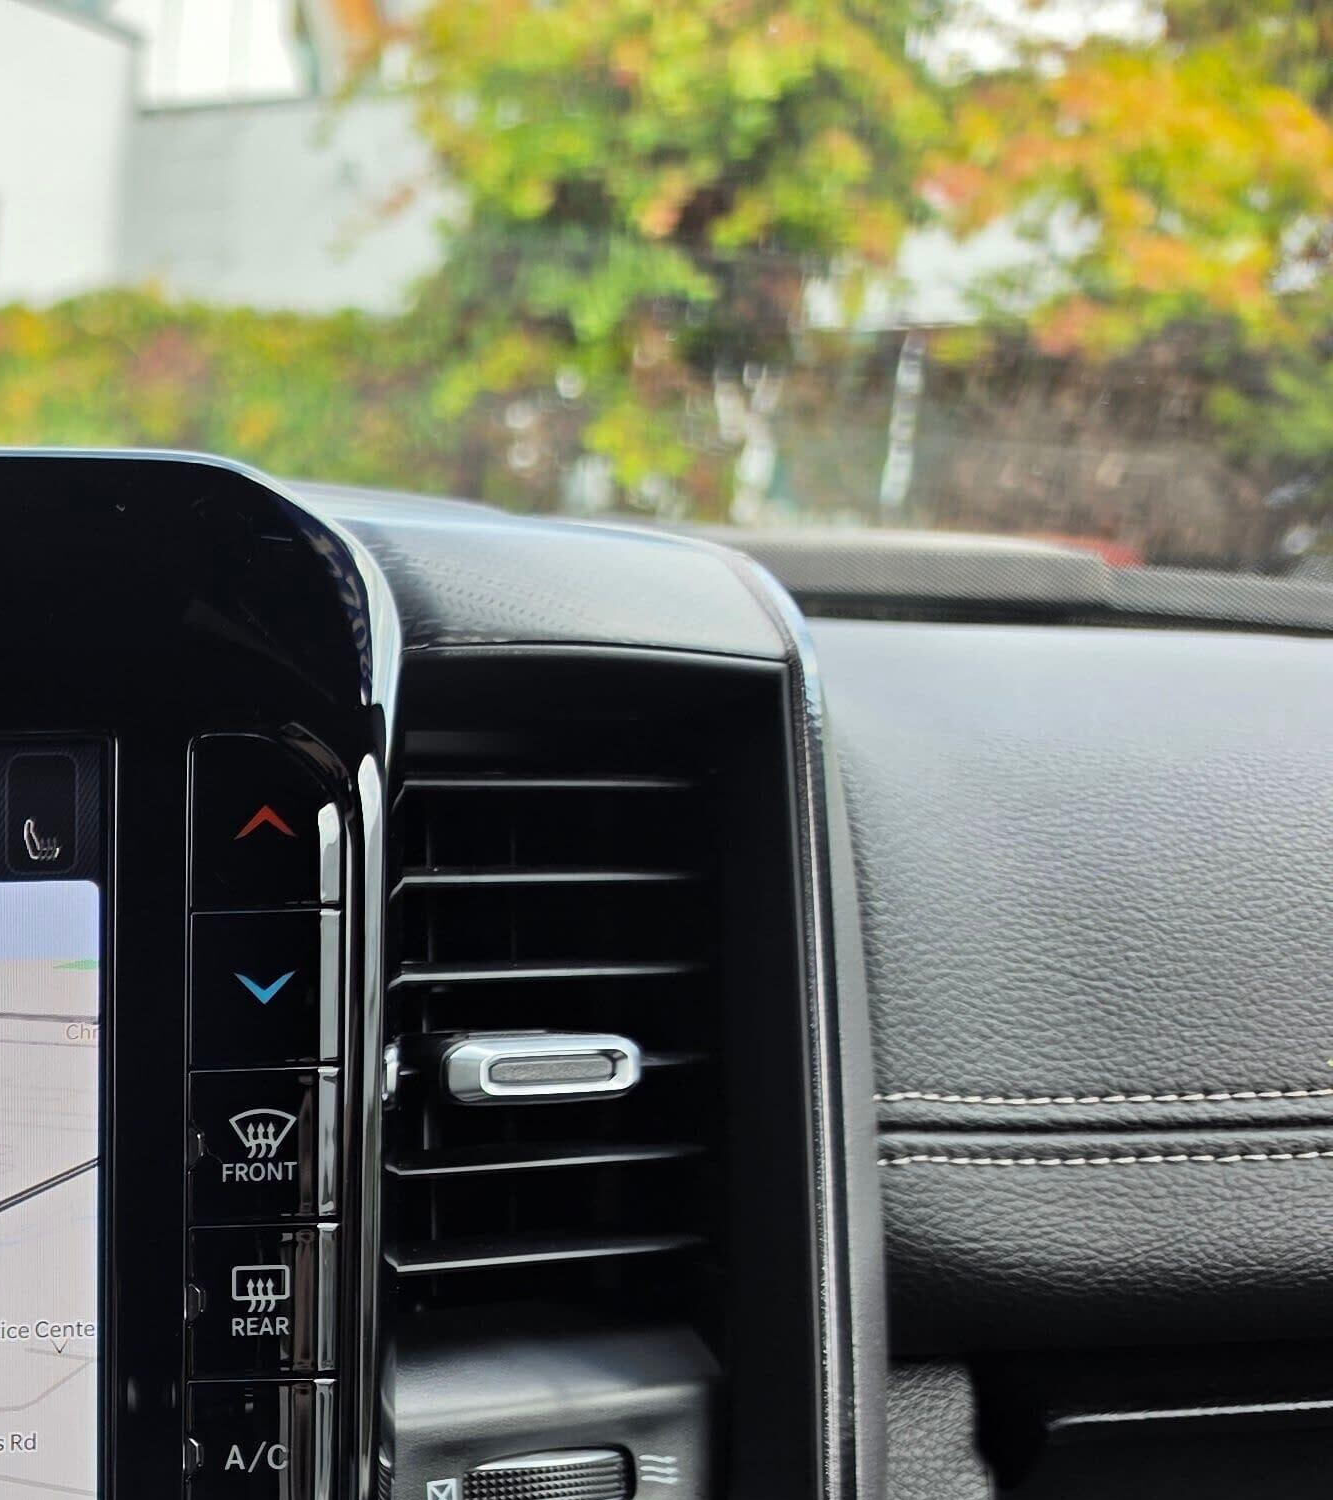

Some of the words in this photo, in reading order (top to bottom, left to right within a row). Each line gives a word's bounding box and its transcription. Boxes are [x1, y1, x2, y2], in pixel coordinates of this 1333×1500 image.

[222, 1161, 298, 1183] FRONT
[231, 1316, 290, 1337] REAR
[11, 1434, 37, 1451] Rd
[224, 1441, 290, 1473] A/C
